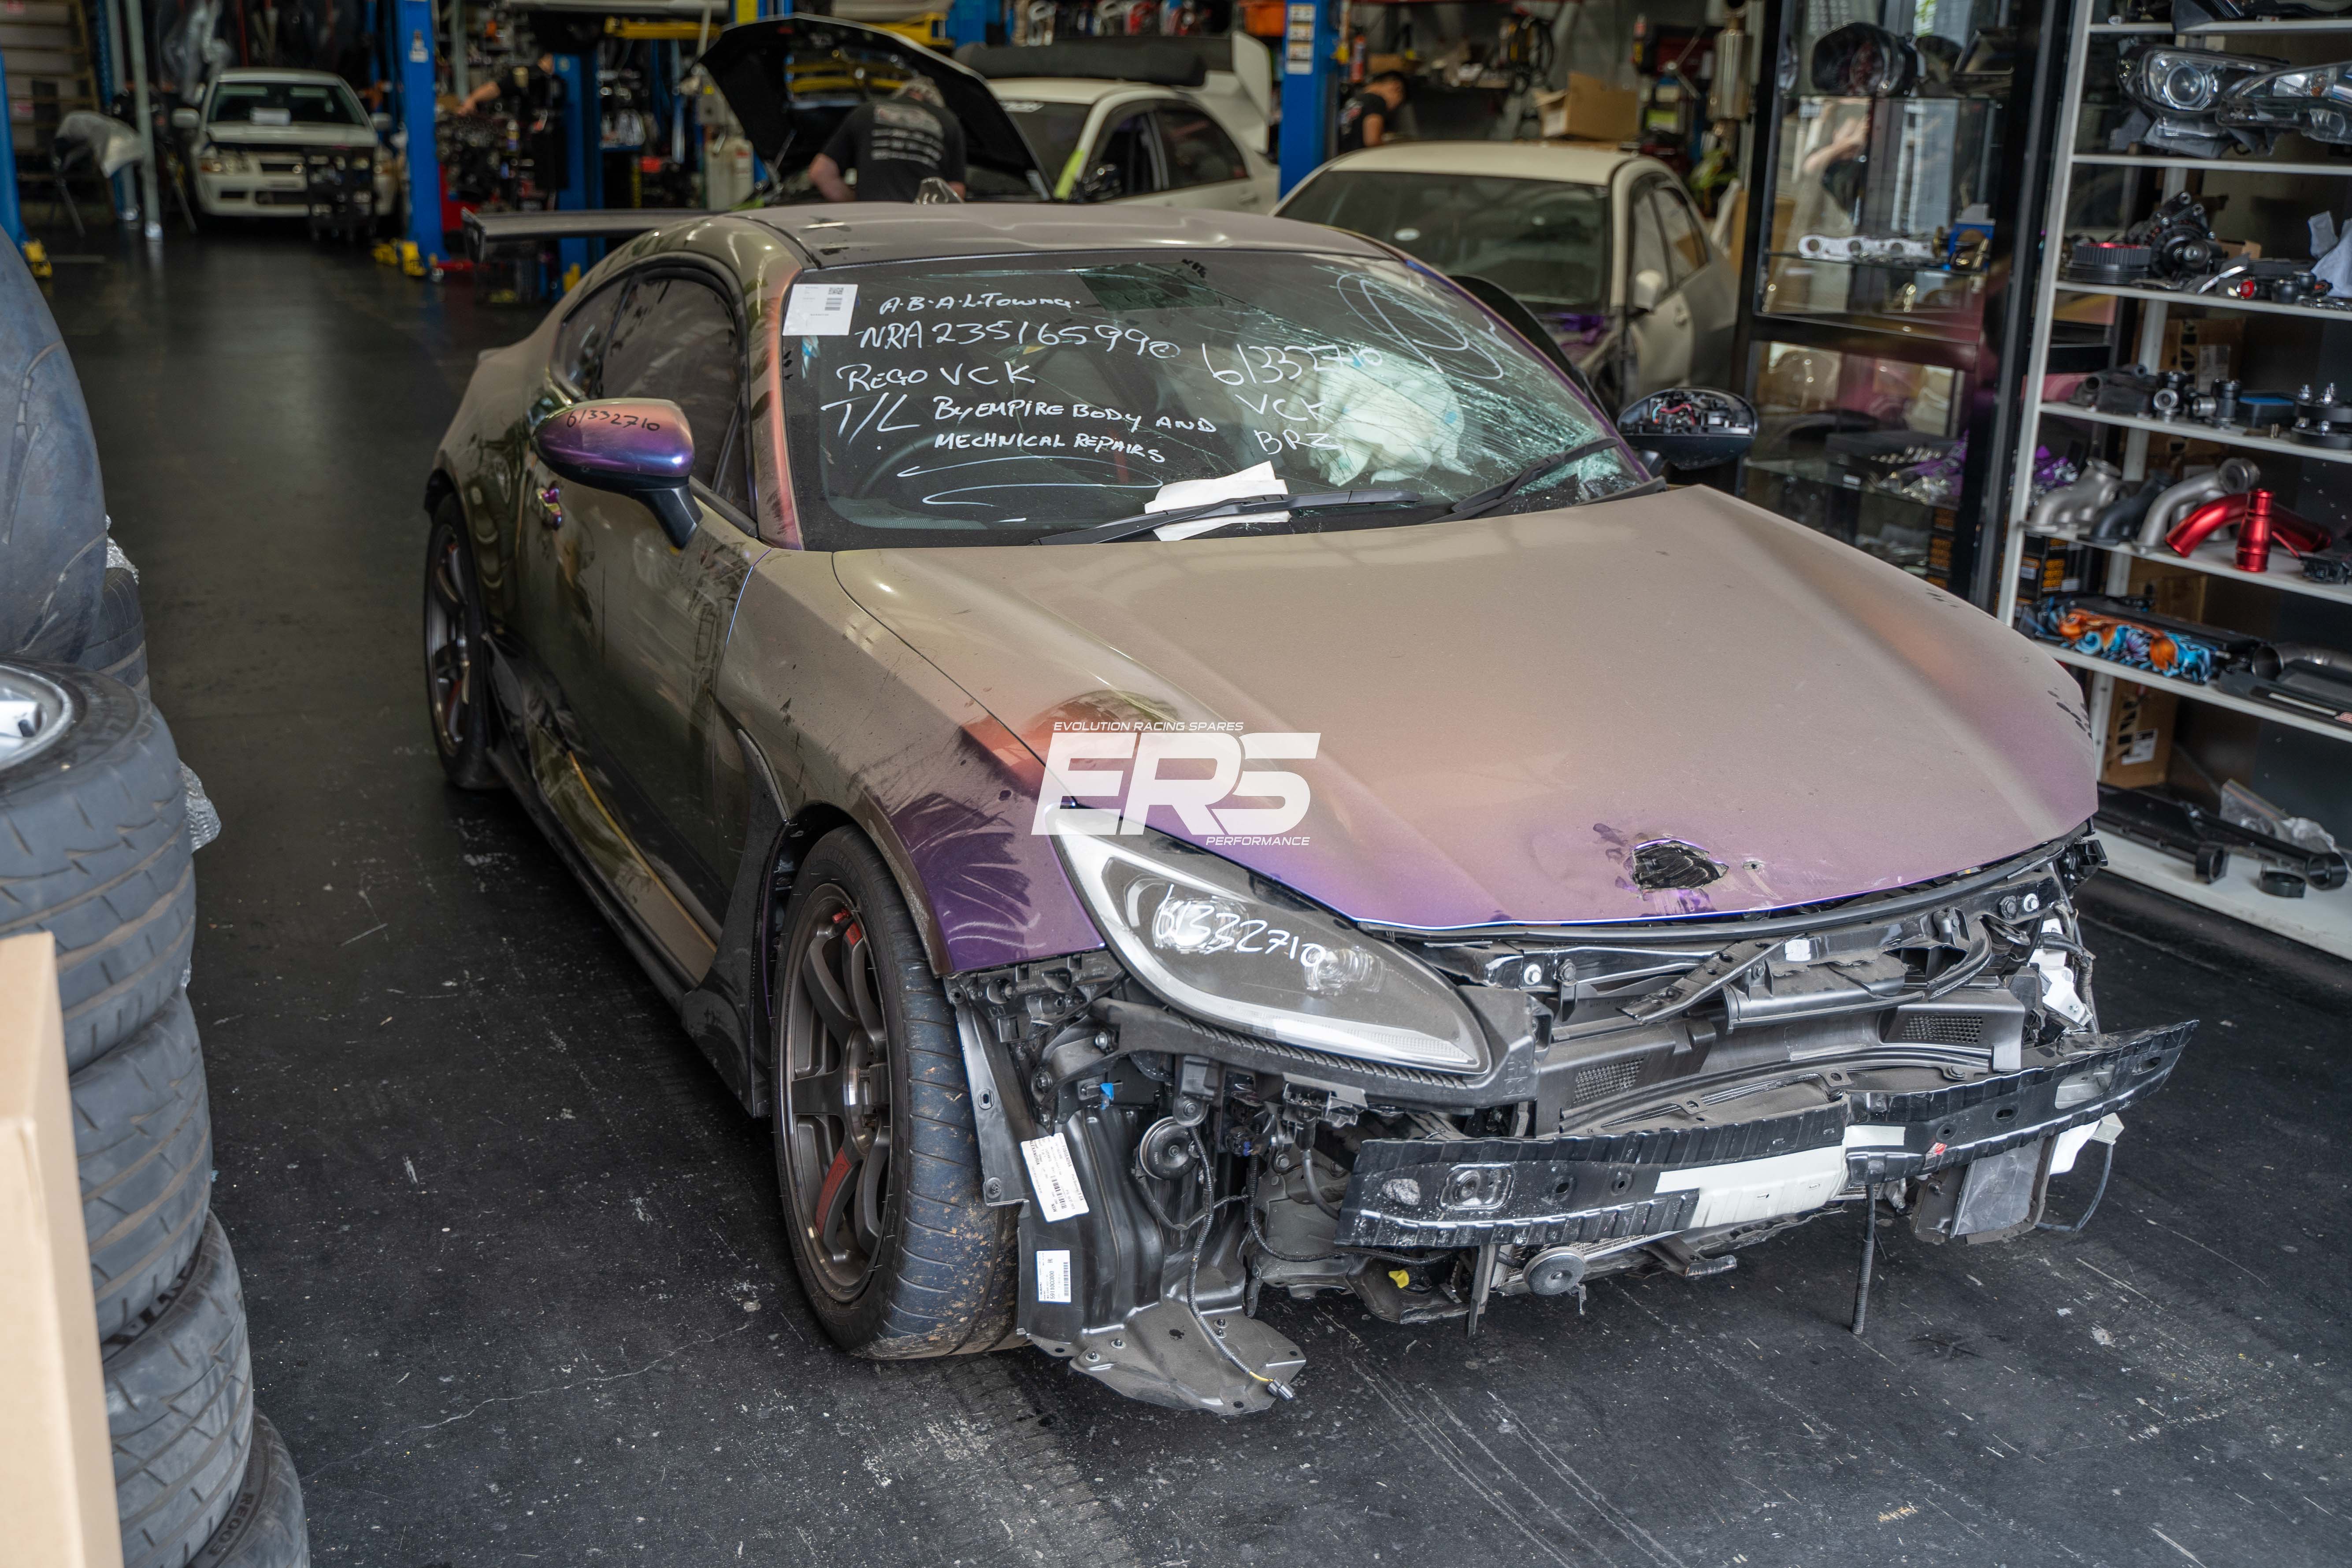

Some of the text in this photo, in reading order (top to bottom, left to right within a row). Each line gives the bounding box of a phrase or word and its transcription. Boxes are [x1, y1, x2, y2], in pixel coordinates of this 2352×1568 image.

[855, 320, 922, 349] NRA
[940, 360, 1036, 386] VCK
[1235, 394, 1334, 424] VCK
[1155, 416, 1217, 433] AND
[934, 432, 1165, 463] MECHNICAL REPAIRS
